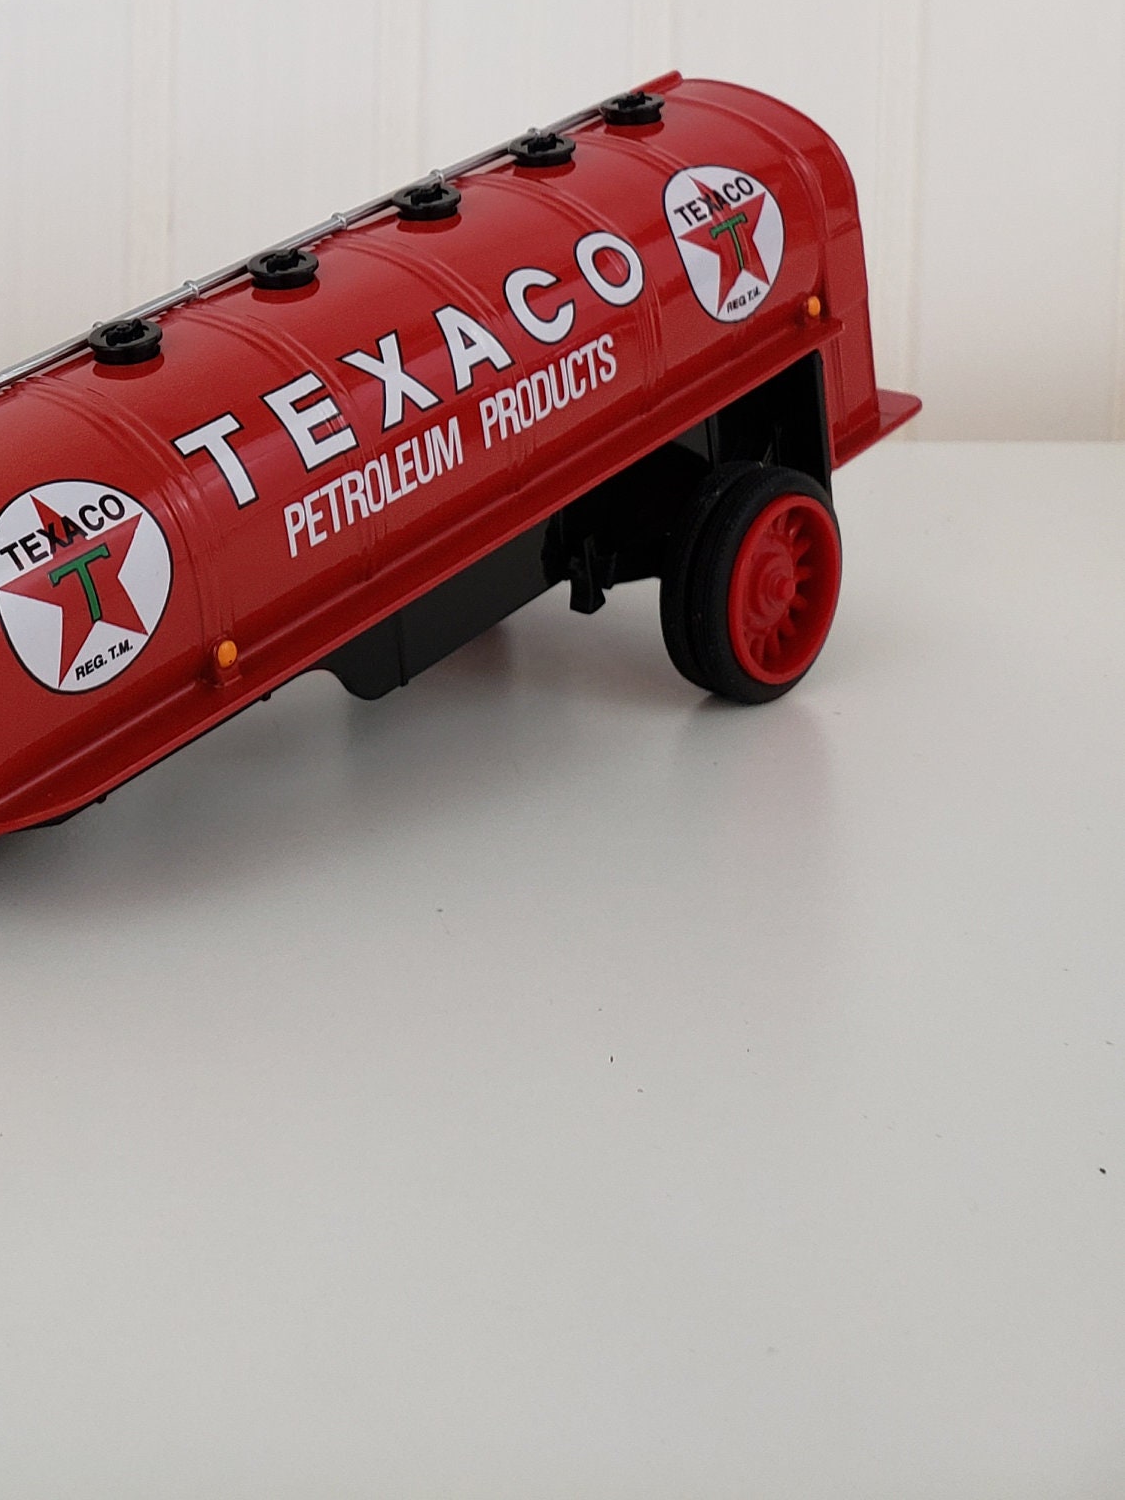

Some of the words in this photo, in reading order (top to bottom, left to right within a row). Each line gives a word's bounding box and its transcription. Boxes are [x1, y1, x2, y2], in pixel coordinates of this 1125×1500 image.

[673, 176, 754, 227] TEXACO
[709, 212, 748, 272] T
[171, 230, 645, 509] TEXACO
[283, 416, 465, 559] PETROLEUM
[478, 333, 618, 450] PRODUCTS
[47, 542, 111, 624] T
[74, 653, 108, 681] REG.
[108, 639, 134, 661] T.M.
